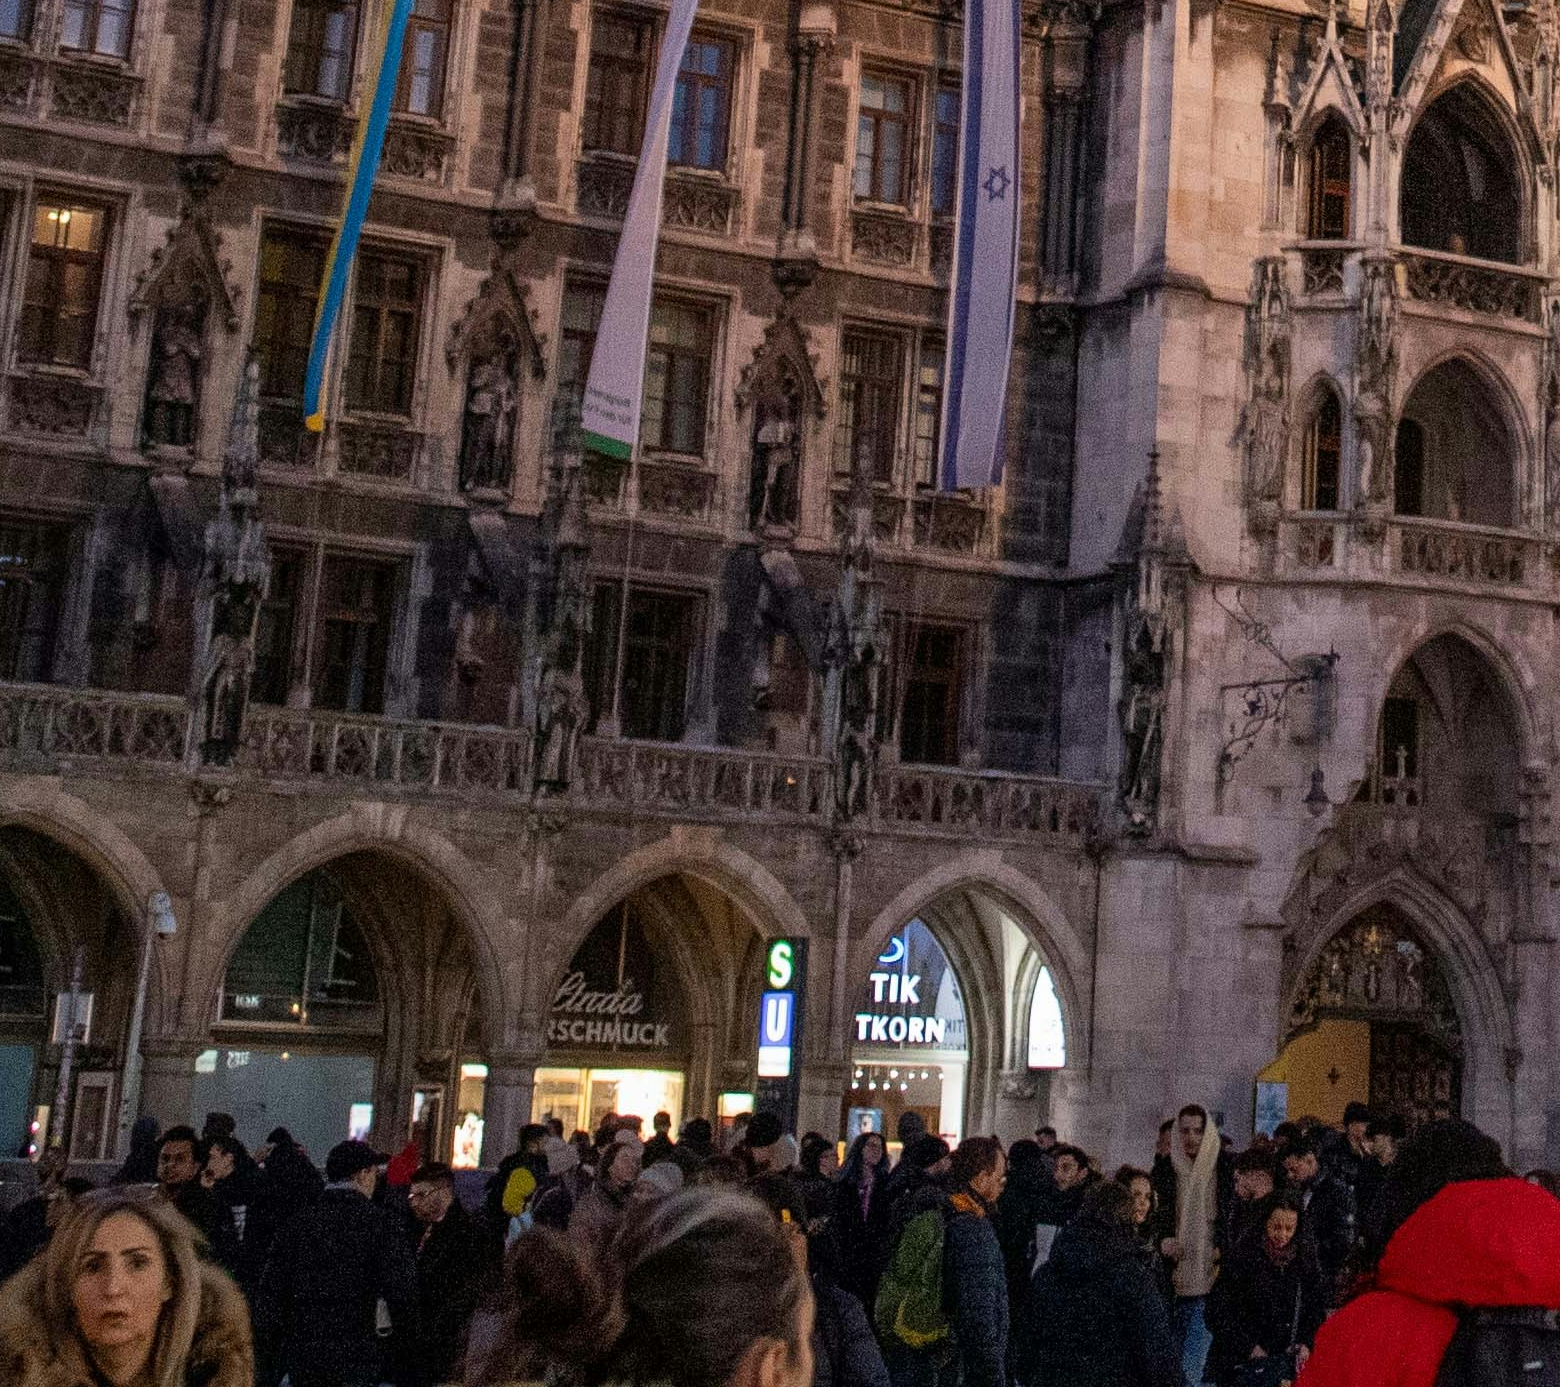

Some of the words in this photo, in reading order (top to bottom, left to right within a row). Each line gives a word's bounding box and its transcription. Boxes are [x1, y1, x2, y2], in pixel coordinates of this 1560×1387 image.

[769, 942, 793, 989] S
[870, 973, 921, 1004] TIK
[766, 998, 789, 1043] U
[855, 1013, 945, 1043] TKORN
